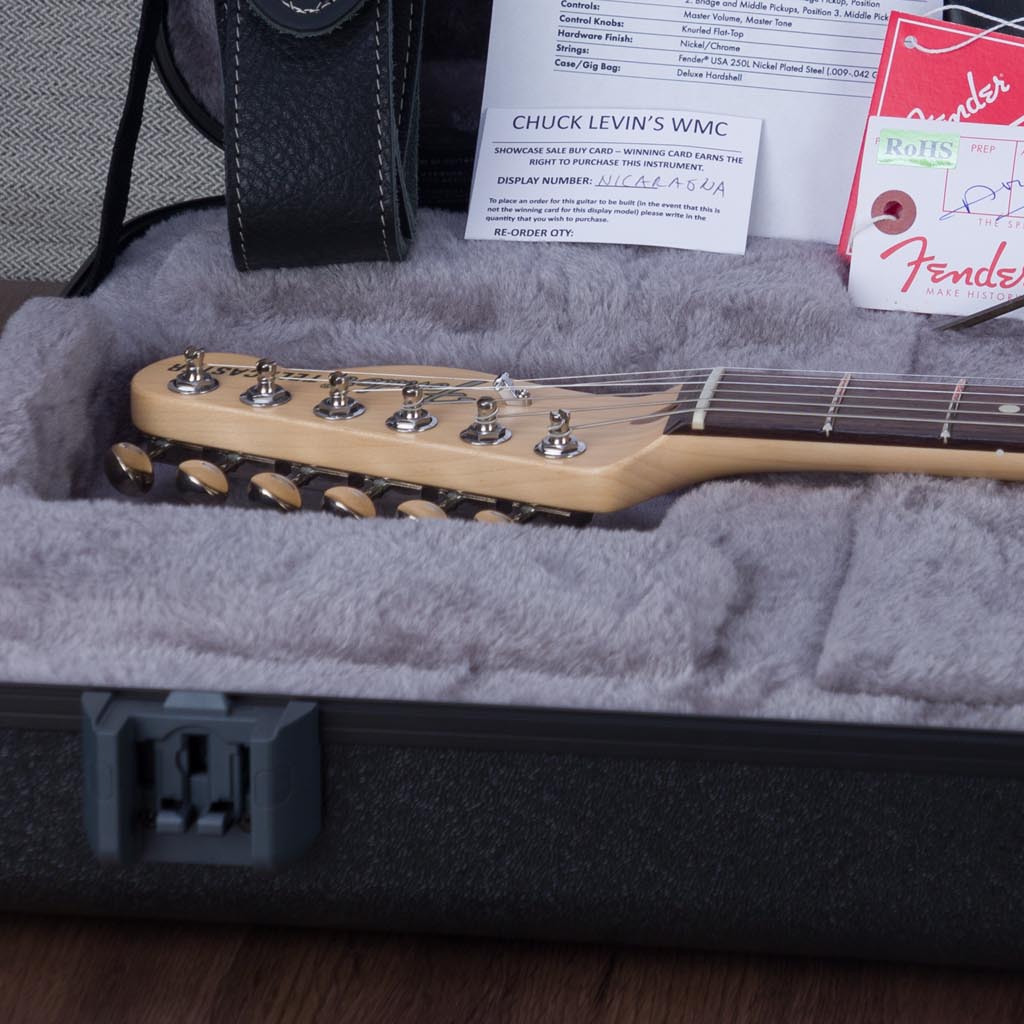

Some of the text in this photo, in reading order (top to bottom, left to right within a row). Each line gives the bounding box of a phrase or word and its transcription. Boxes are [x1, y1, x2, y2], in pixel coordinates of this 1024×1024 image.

[560, 0, 600, 10] Controls:
[559, 14, 624, 27] Control Knobs:
[557, 29, 632, 42] Hardware Finish:
[556, 44, 589, 55] Strings:
[680, 40, 740, 52] Nickel/Chrome
[554, 59, 620, 73] Case/Gig Bag:
[677, 69, 742, 81] Deluxe Hardshell
[512, 115, 727, 136] CHUCK LEVIN'S WMC
[886, 137, 954, 160] RoHS
[971, 144, 996, 153] PREP
[623, 148, 665, 156] WINNING
[668, 150, 692, 158] CARD
[695, 152, 724, 161] EARNS
[727, 156, 742, 164] THE
[644, 161, 703, 171] INSTRUMENT.
[497, 176, 539, 184] DISPLAY
[978, 218, 999, 228] THE
[494, 228, 547, 236] RE-ORDER
[926, 288, 960, 297] MAKE
